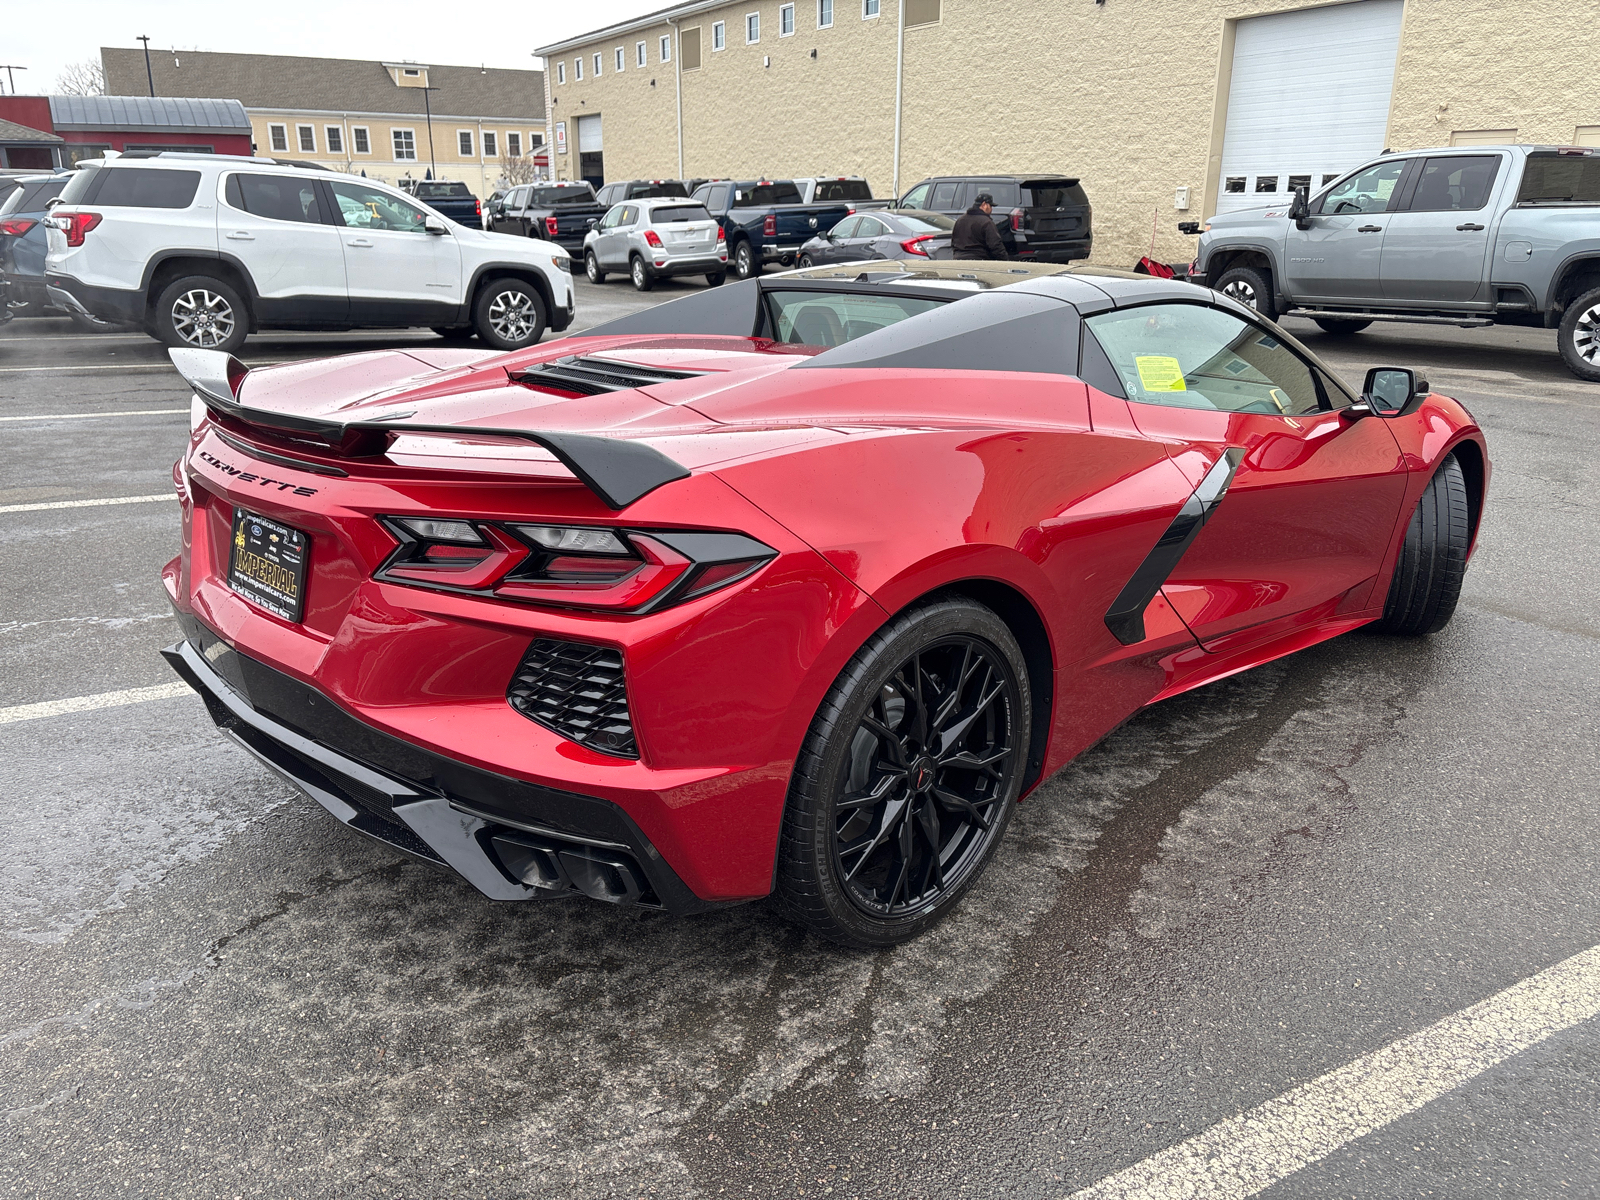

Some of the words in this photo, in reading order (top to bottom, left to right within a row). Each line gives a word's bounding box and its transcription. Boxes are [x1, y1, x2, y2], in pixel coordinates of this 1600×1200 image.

[199, 451, 318, 497] CORVETTE
[234, 570, 296, 606] www.imperialcars.com
[235, 547, 297, 598] IMPERIAL
[1004, 696, 1012, 736] FORGED
[815, 813, 834, 896] MICHELIN
[850, 885, 883, 910] CORVETTE
